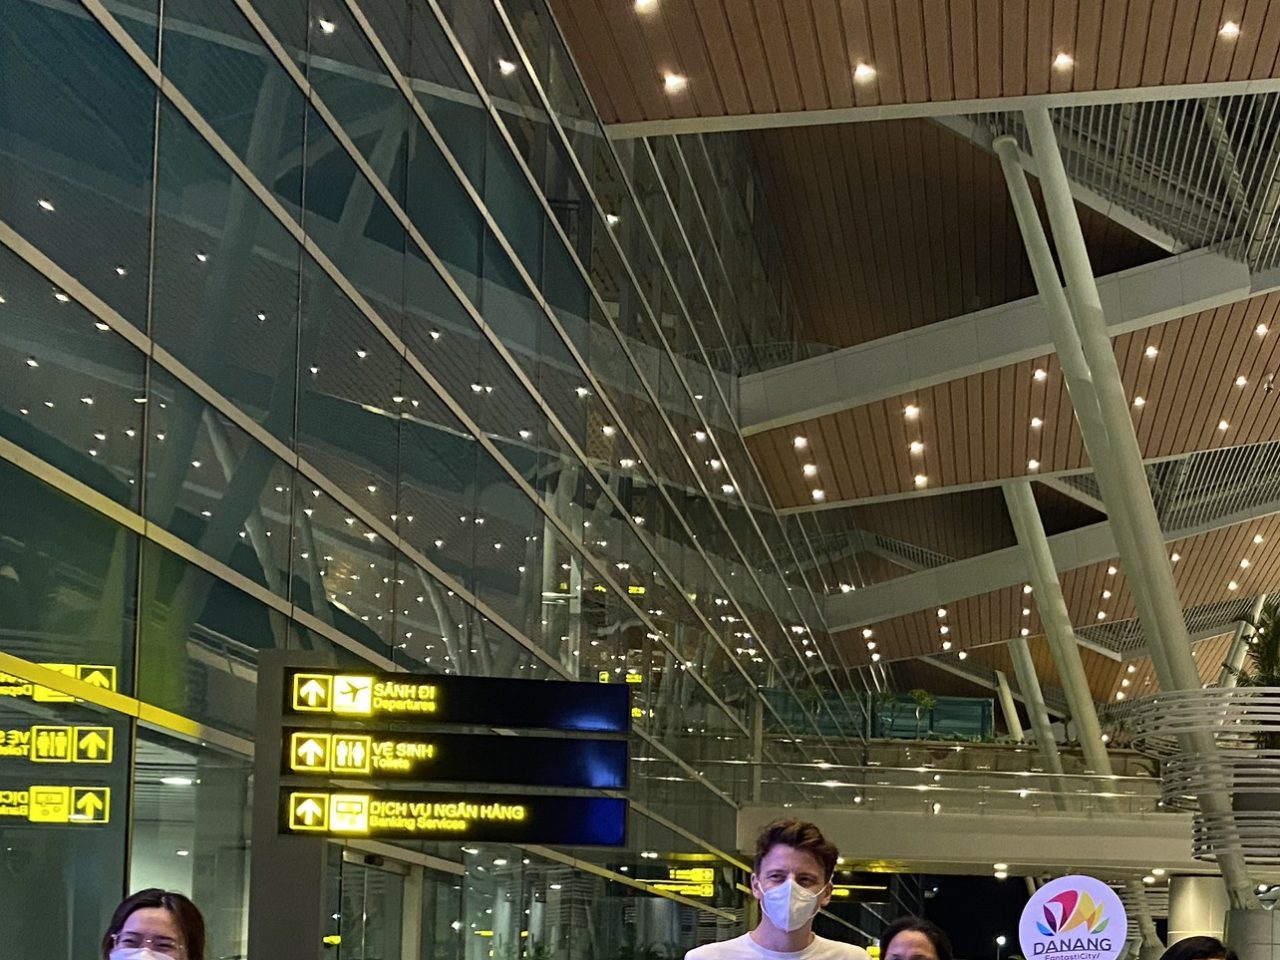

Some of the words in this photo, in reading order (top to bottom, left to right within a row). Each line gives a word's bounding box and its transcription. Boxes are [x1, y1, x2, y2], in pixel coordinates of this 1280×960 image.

[418, 686, 435, 699] ĐI
[373, 697, 435, 712] Departures
[396, 743, 433, 758] SINH
[372, 756, 411, 769] Toilets
[370, 801, 407, 817] DỊCH
[409, 803, 432, 818] VỤ
[434, 801, 478, 818] NGÂN
[481, 803, 525, 819] HÀNG
[369, 815, 415, 830] Banking
[417, 817, 466, 830] Services
[1033, 938, 1112, 956] DANANG
